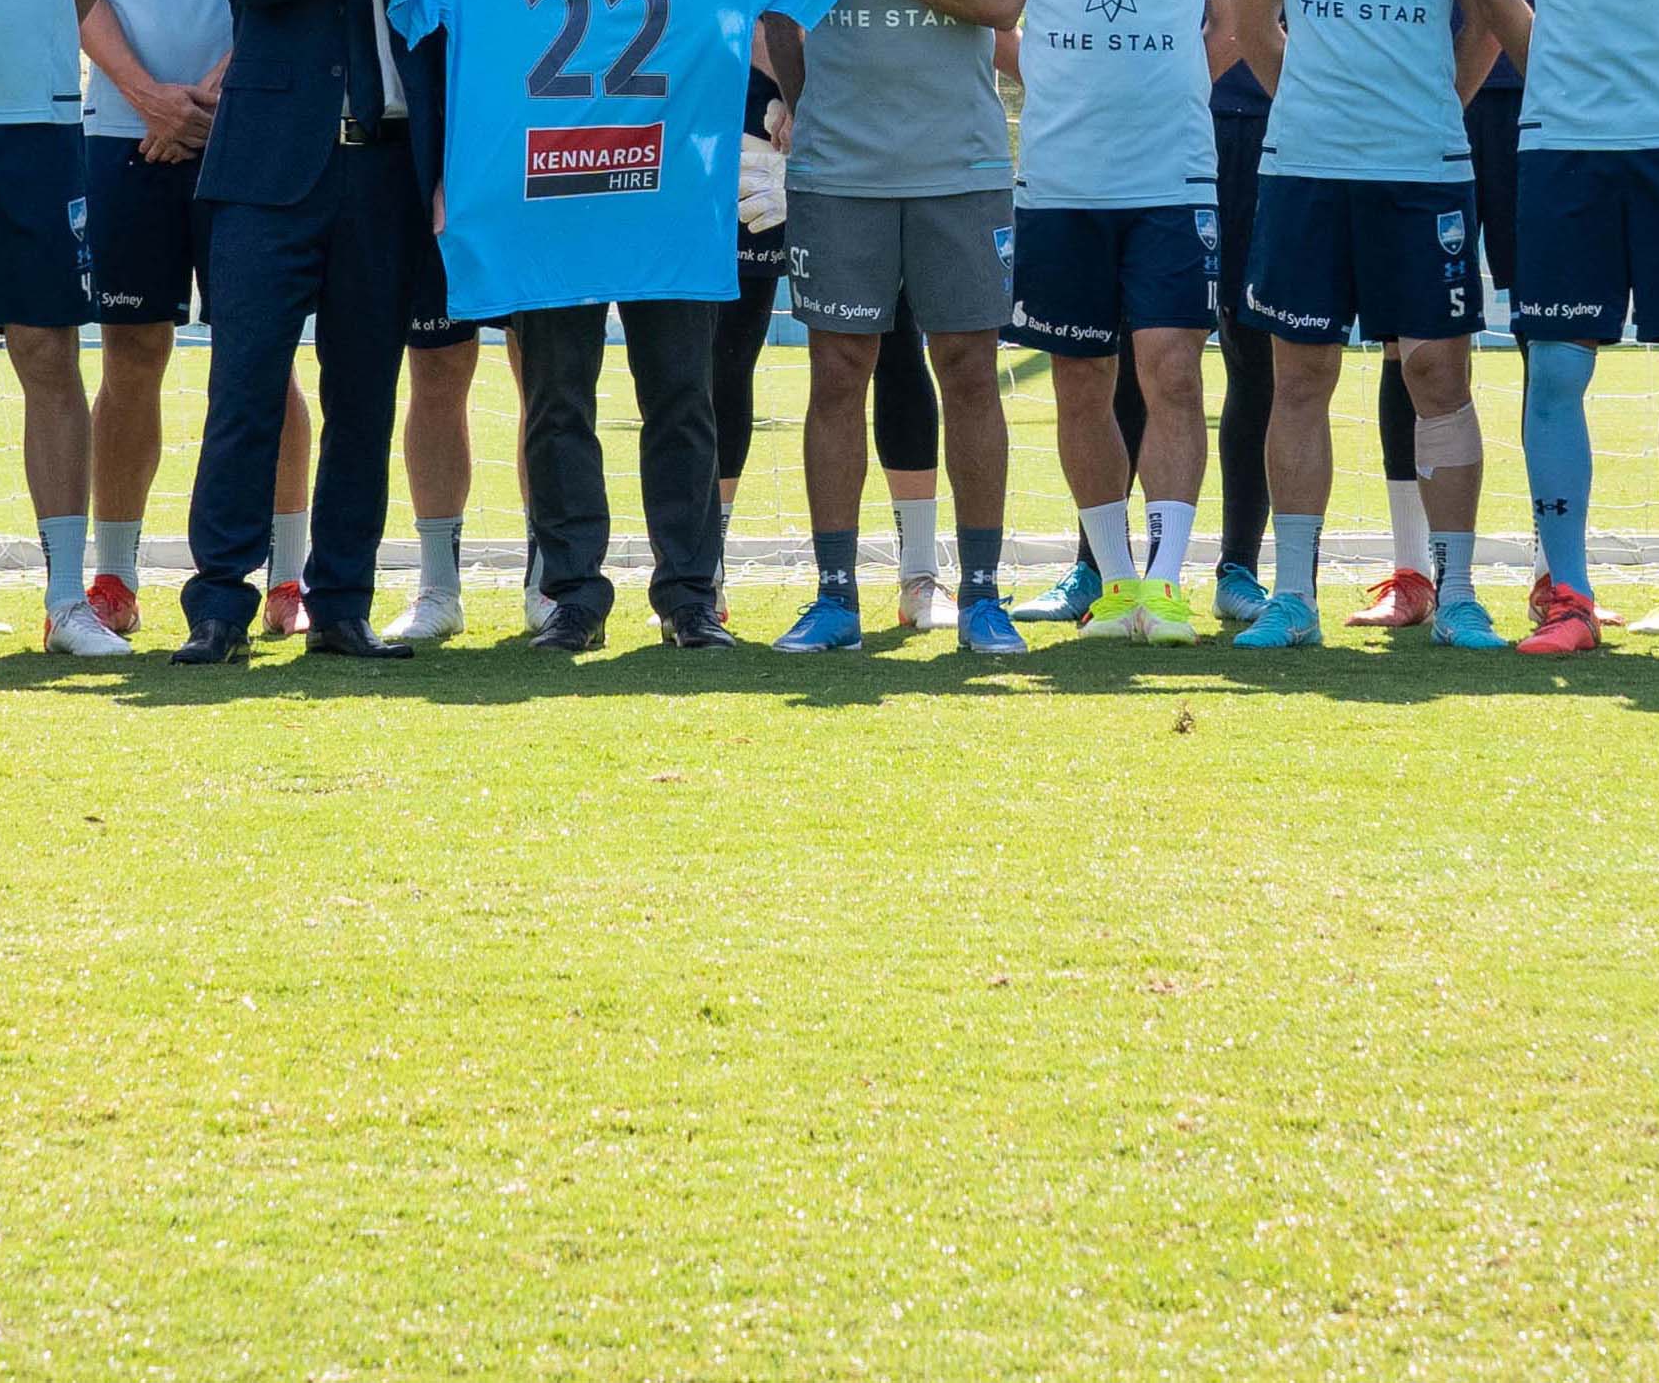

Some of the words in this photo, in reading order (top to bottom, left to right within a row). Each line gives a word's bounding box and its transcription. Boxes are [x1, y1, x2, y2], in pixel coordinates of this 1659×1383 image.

[828, 9, 871, 28] THE
[1359, 3, 1427, 24] STAR
[1048, 31, 1094, 50] THE
[1108, 33, 1175, 52] STAR
[532, 144, 657, 171] KENNARDS
[608, 171, 654, 191] HIRE
[756, 249, 769, 263] of
[790, 246, 810, 279] SC
[101, 291, 143, 309] Sydney
[803, 295, 822, 313] Bnk
[824, 302, 837, 316] of
[839, 301, 881, 321] Sydney
[1450, 287, 1466, 318] 5
[1545, 301, 1559, 317] of
[1561, 302, 1603, 319] Sydney
[1028, 316, 1052, 334] Bank
[1055, 323, 1068, 337] of
[1070, 324, 1112, 343] Sydney
[1278, 309, 1287, 323] of
[1288, 311, 1331, 330] Sydney
